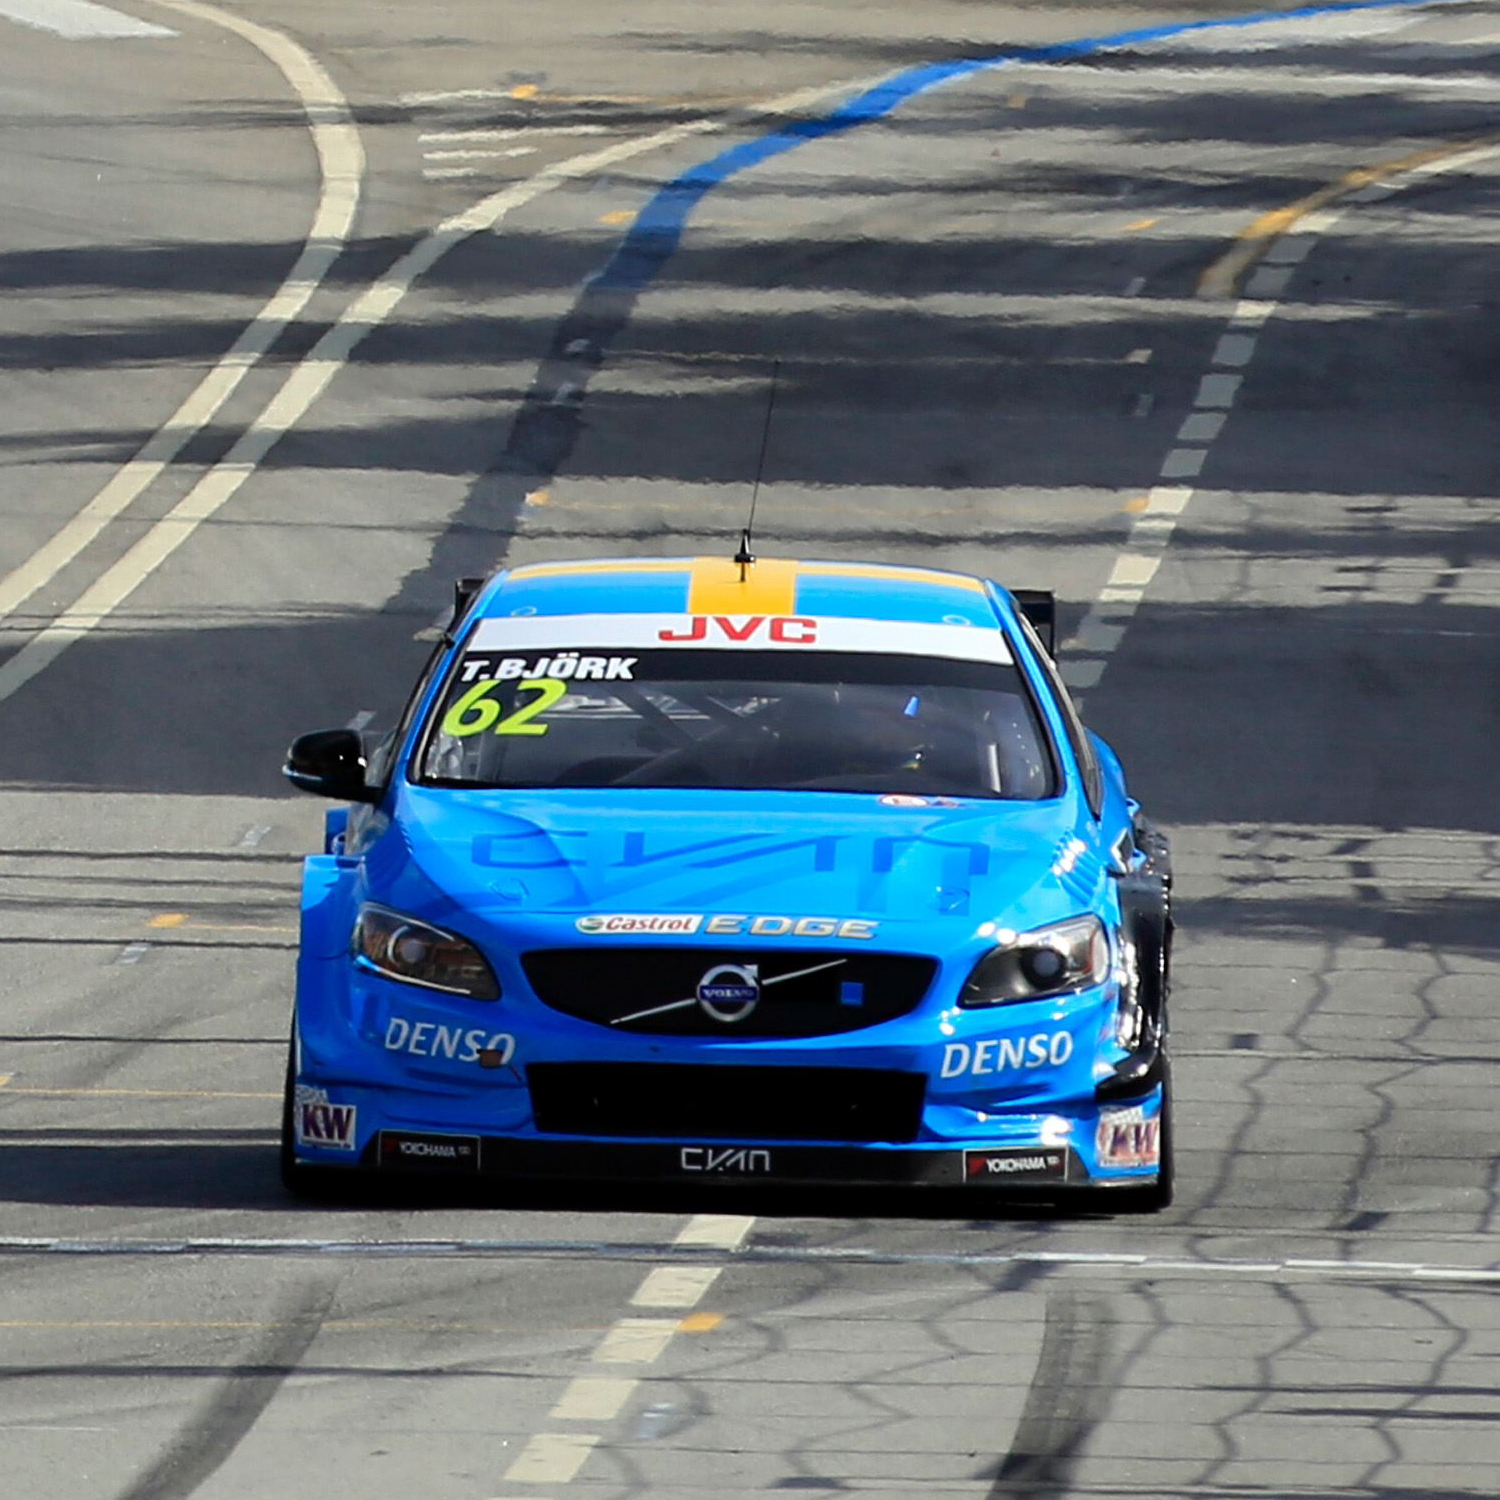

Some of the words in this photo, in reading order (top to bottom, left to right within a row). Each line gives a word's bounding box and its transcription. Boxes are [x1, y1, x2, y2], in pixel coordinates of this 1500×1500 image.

[658, 616, 817, 644] JVC
[441, 678, 568, 737] 62
[605, 915, 694, 932] Castrol
[705, 913, 881, 940] EDGE
[702, 988, 755, 999] VOLVO
[384, 1016, 517, 1065] DENSO
[939, 1030, 1074, 1079] DENSO
[302, 1104, 354, 1142] KW
[399, 1141, 457, 1159] YOKOHAMA
[985, 1155, 1047, 1174] YOKOHAMA
